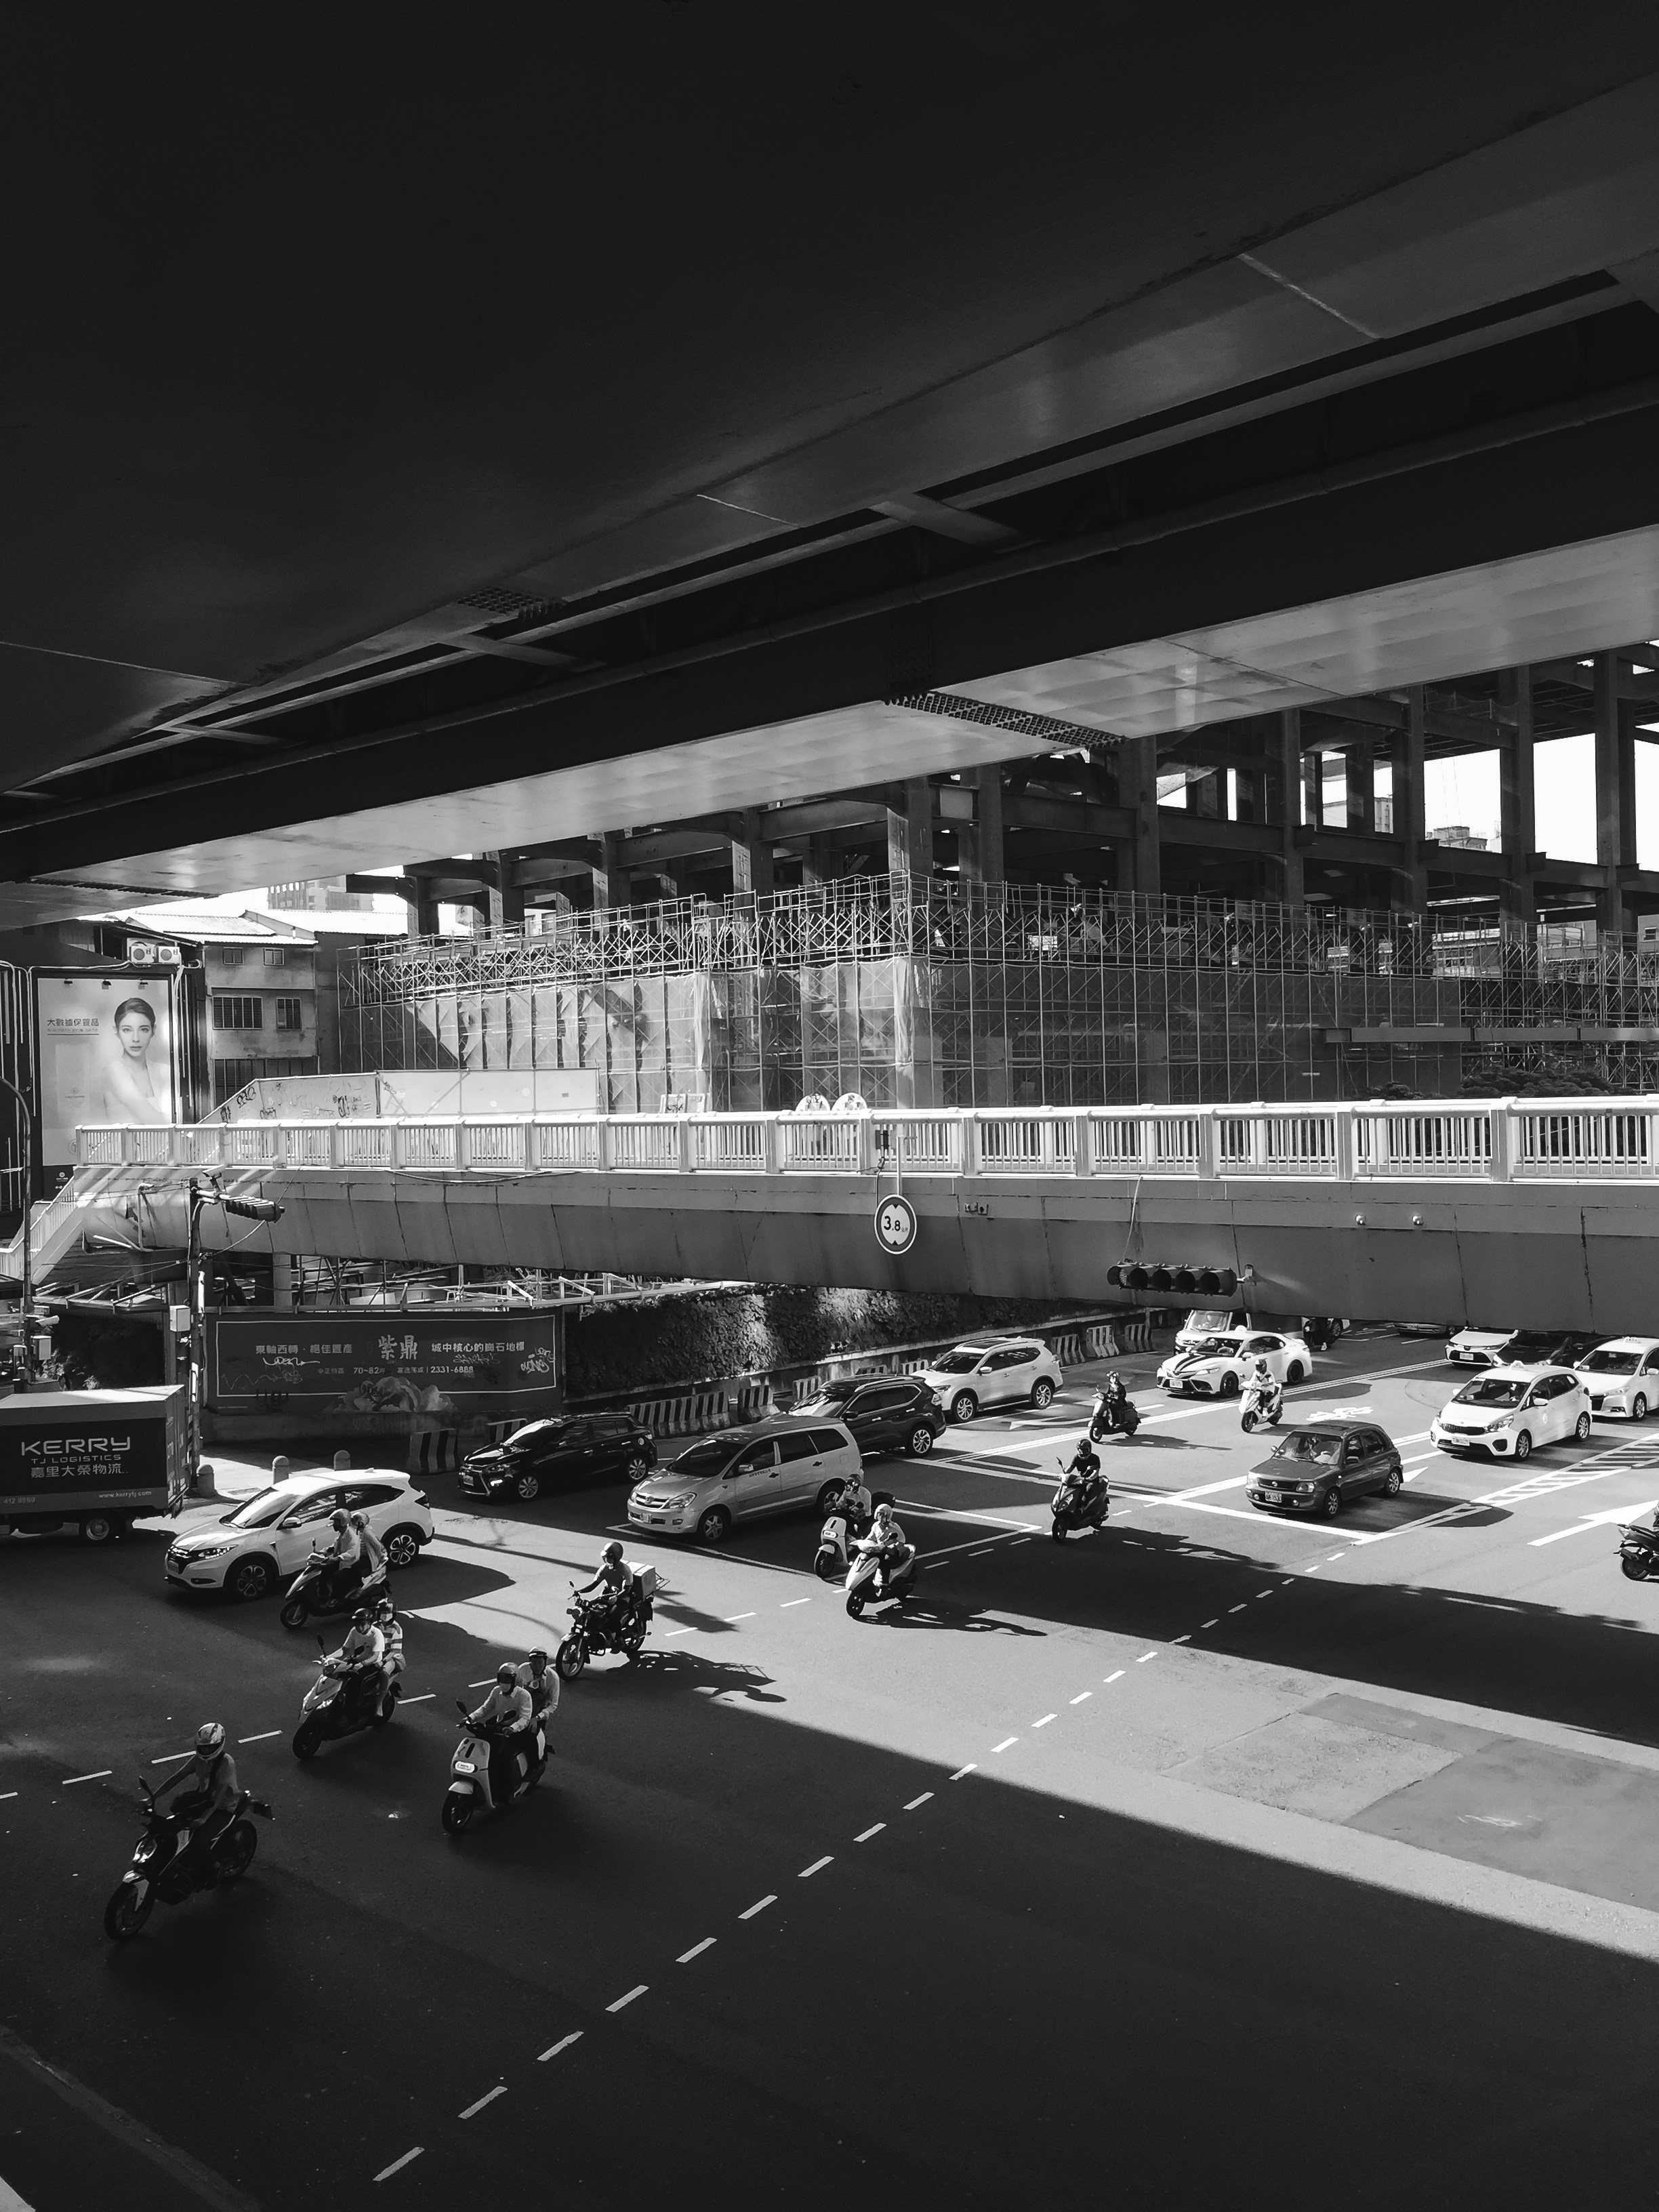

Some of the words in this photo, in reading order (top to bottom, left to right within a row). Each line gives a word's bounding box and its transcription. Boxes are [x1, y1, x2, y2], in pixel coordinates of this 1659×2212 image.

[884, 1215, 901, 1231] 3.8
[378, 1334, 418, 1360] 紫鼎
[430, 1366, 474, 1374] 2331-6888
[21, 1436, 131, 1456] KERRY
[52, 1454, 121, 1464] LOGISTICS
[30, 1463, 121, 1478] 嘉里大榮物流
